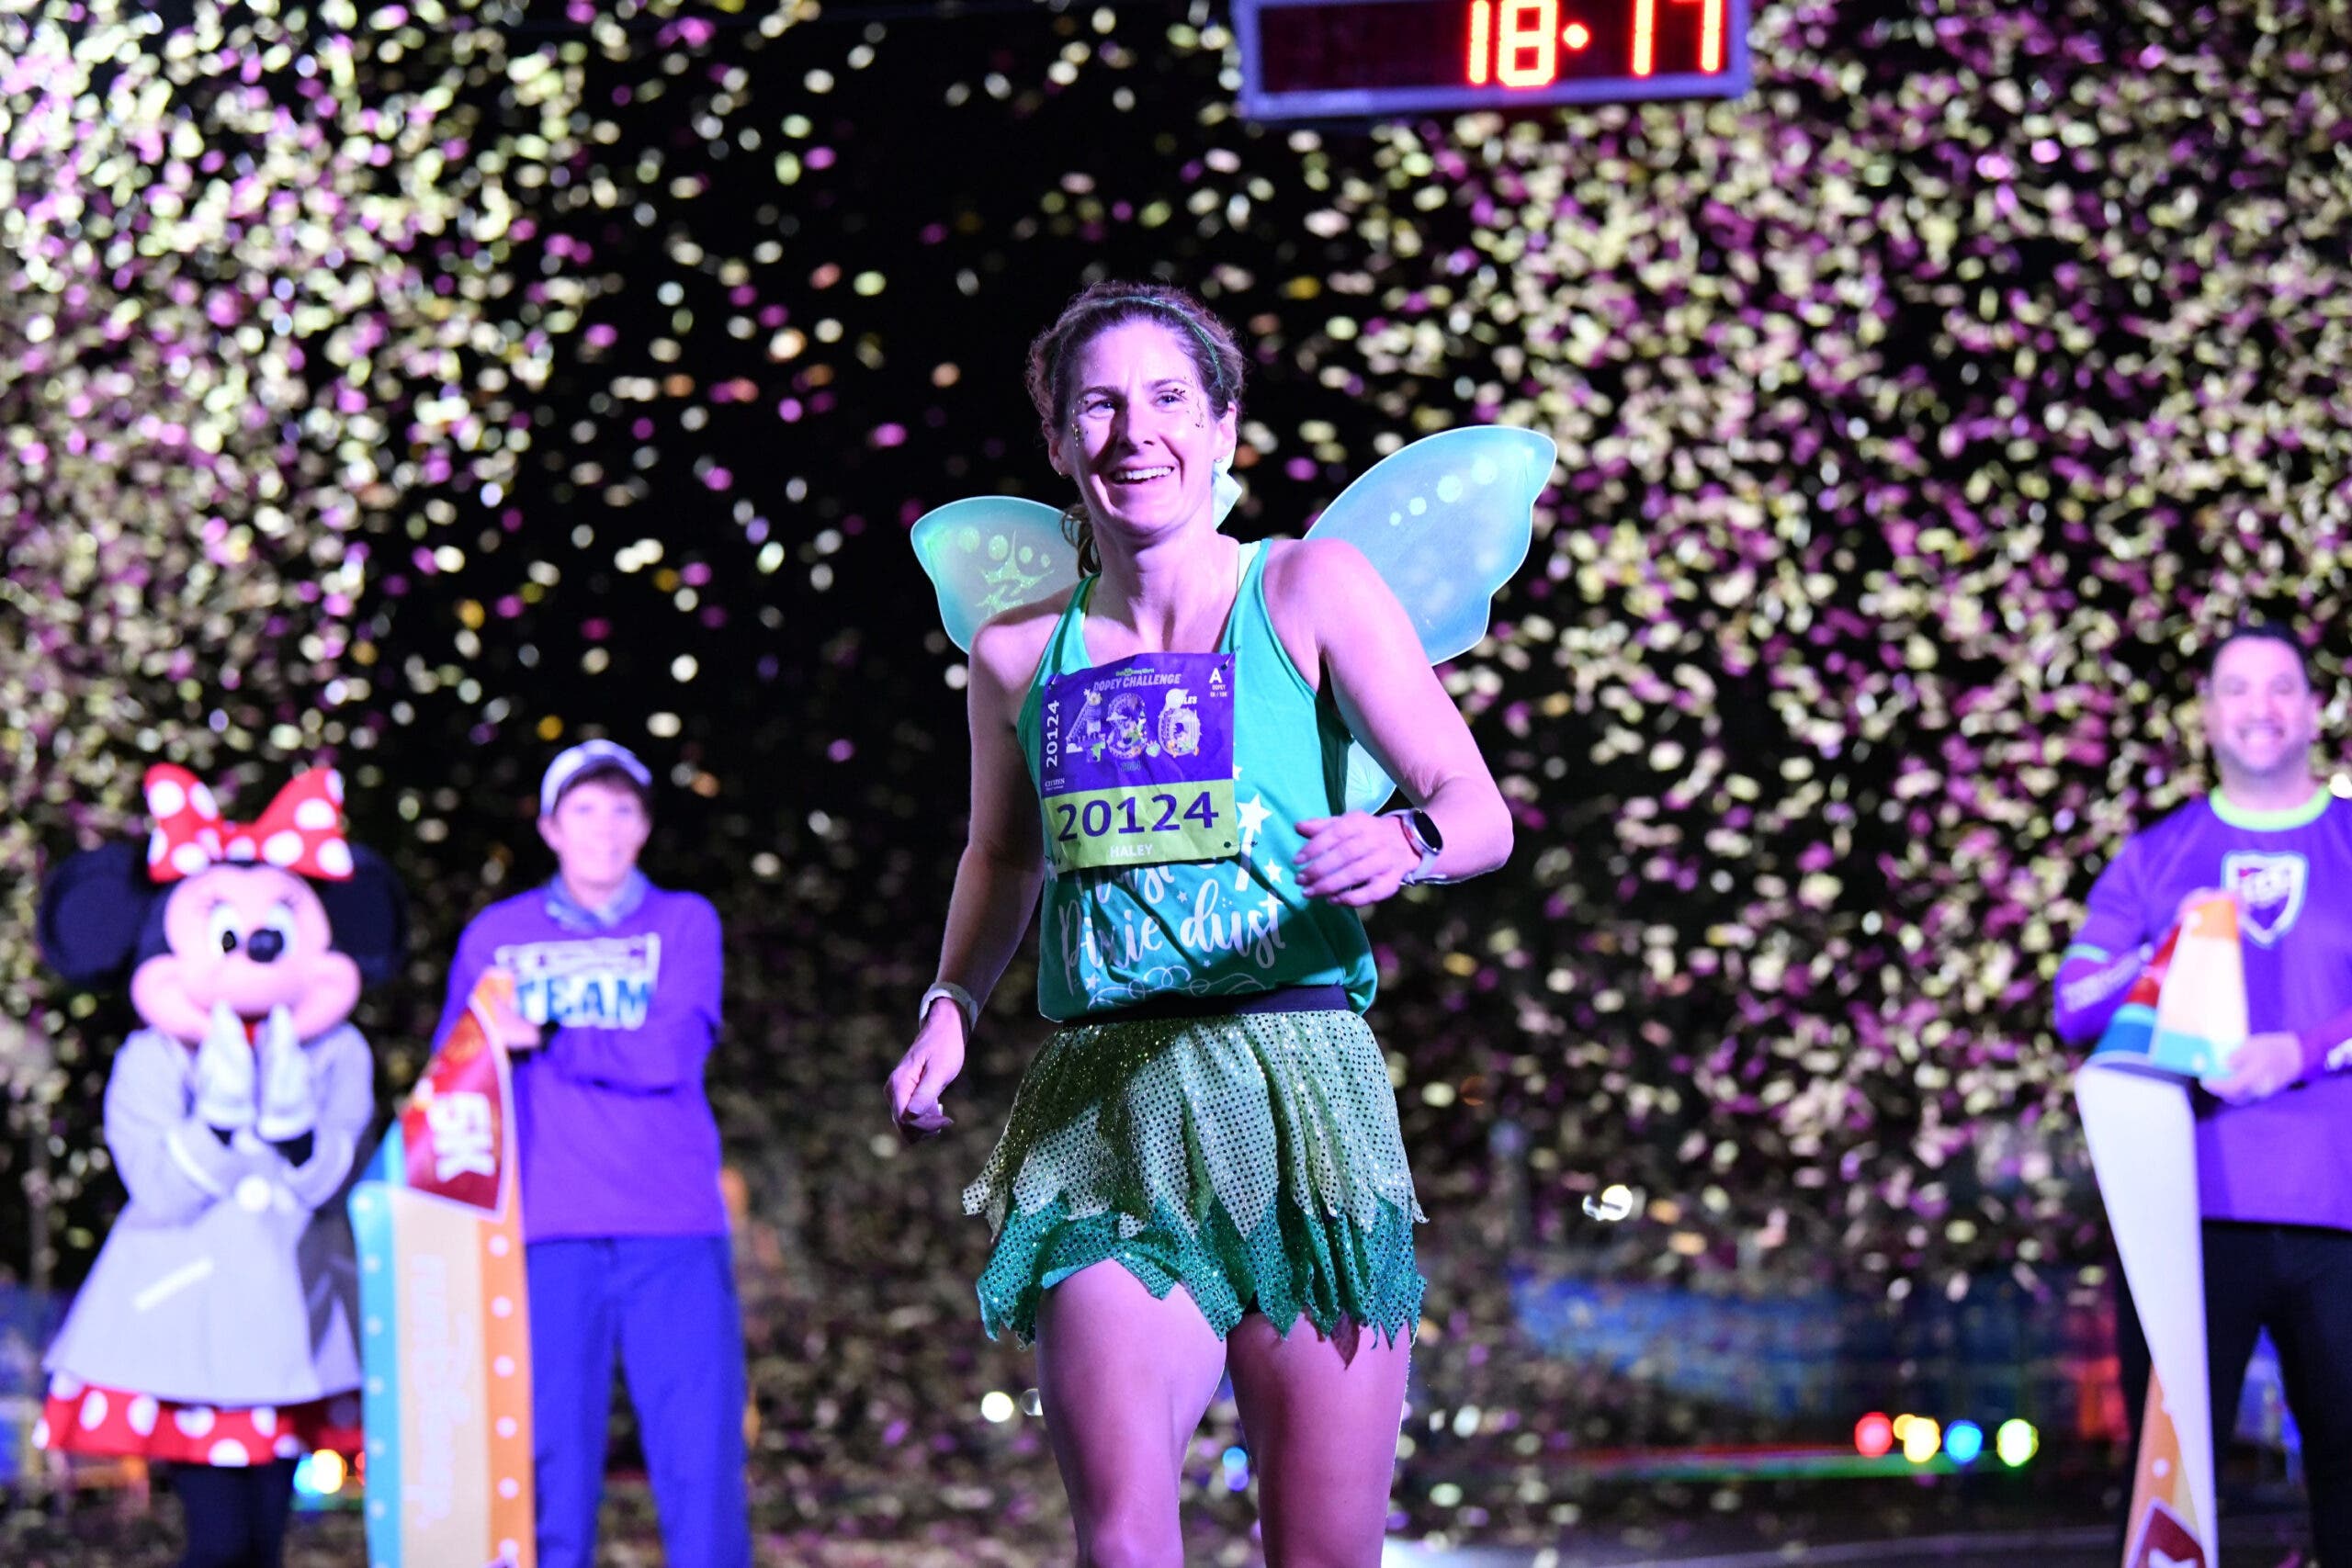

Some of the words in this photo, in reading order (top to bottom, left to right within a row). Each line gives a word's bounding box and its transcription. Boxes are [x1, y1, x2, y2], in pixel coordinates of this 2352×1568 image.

[1093, 678, 1122, 692] DOPEY
[1123, 673, 1182, 688] CHALLENGE
[1209, 667, 1222, 683] A
[1046, 700, 1059, 768] 20124
[1057, 791, 1219, 842] 20124
[1110, 844, 1153, 859] HALEY
[1180, 878, 1285, 969] dust
